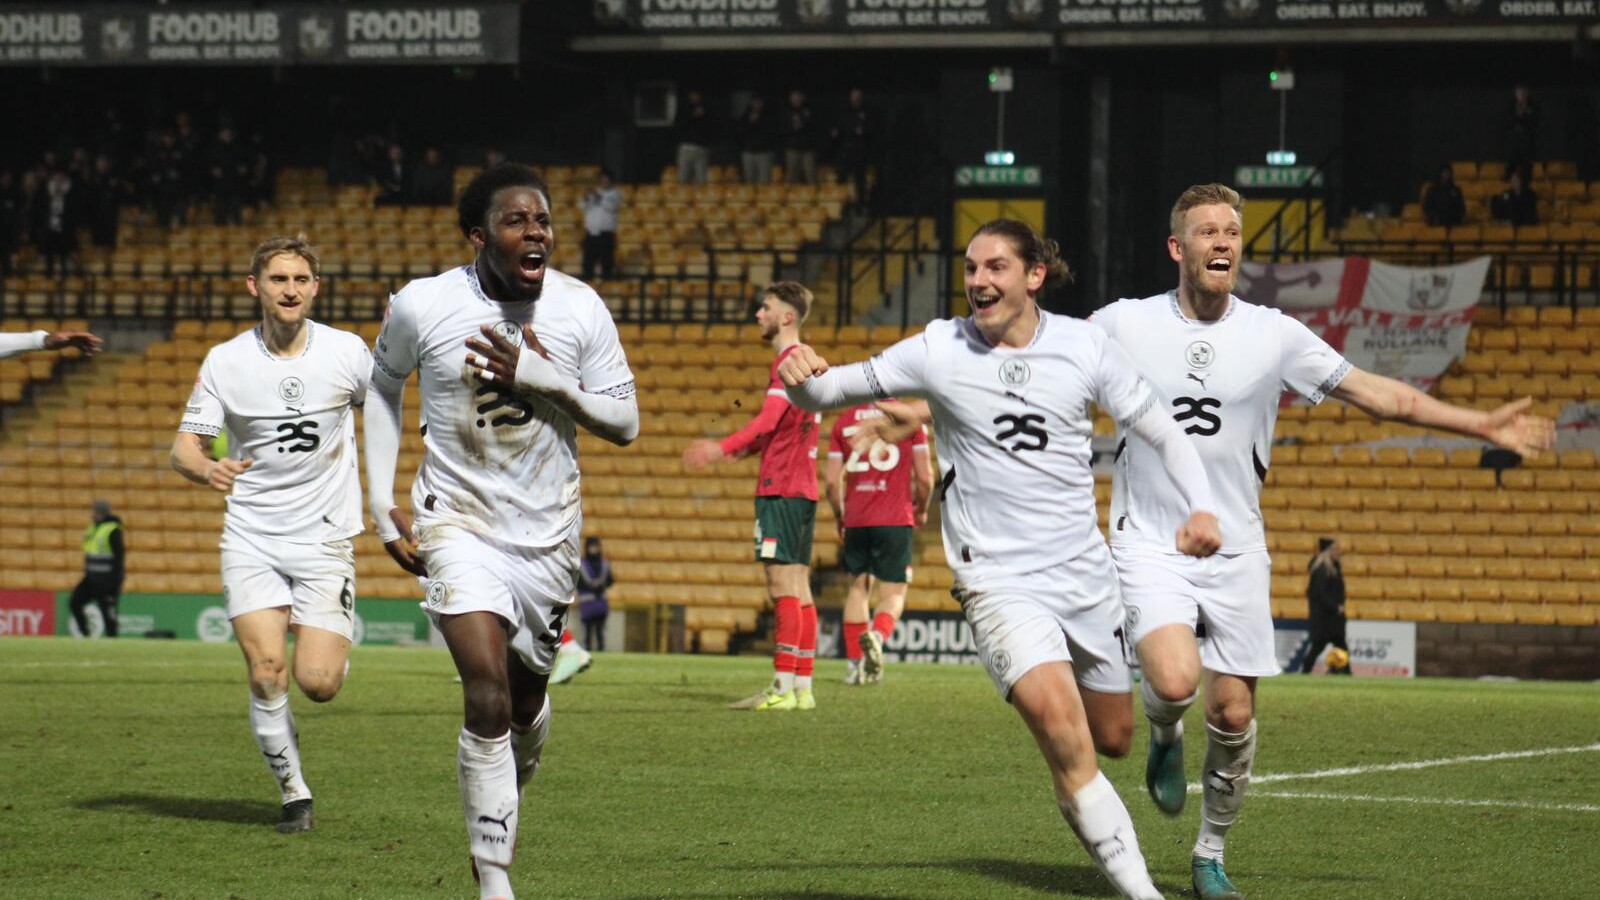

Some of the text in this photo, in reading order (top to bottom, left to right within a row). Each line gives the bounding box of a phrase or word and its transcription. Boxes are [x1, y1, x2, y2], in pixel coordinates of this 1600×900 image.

[346, 9, 481, 41] FOODHUB
[1276, 2, 1428, 20] ORDER. EAT. ENJOY.
[148, 12, 280, 42] FOODHUB
[975, 167, 1017, 184] EXIT
[1256, 167, 1299, 185] EXIT
[842, 424, 900, 473] 26
[340, 577, 353, 611] 6
[885, 618, 979, 652] ODHU
